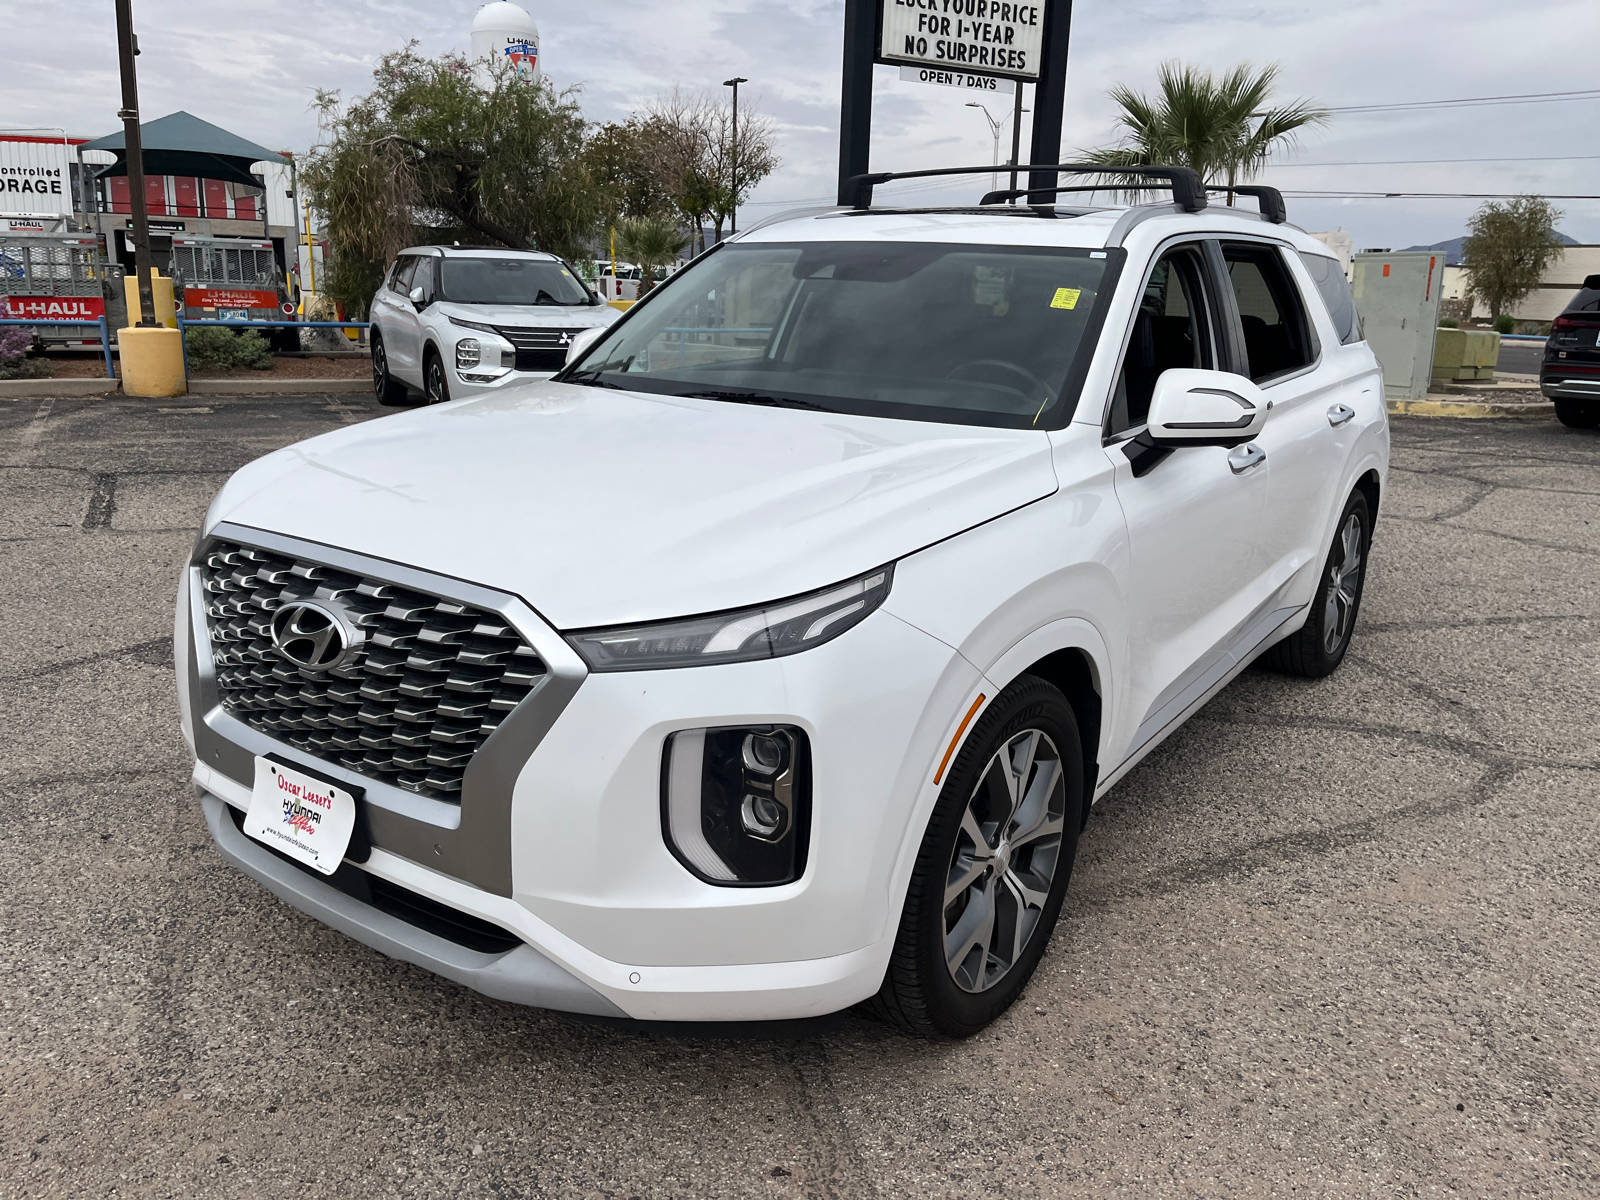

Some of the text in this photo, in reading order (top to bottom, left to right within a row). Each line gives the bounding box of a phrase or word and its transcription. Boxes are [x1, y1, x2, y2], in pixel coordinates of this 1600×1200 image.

[896, 0, 1038, 26] CK YOUR PRICE
[918, 13, 950, 36] FOR
[507, 37, 536, 47] U-HAUL
[904, 35, 1026, 70] NO SURPRISES
[919, 70, 997, 90] OPEN 7 DAYS
[207, 290, 256, 299] U-HAUL
[6, 302, 92, 315] U-HAUL
[277, 774, 331, 810] Oscar Leeser's
[282, 798, 321, 824] HYUNDAI
